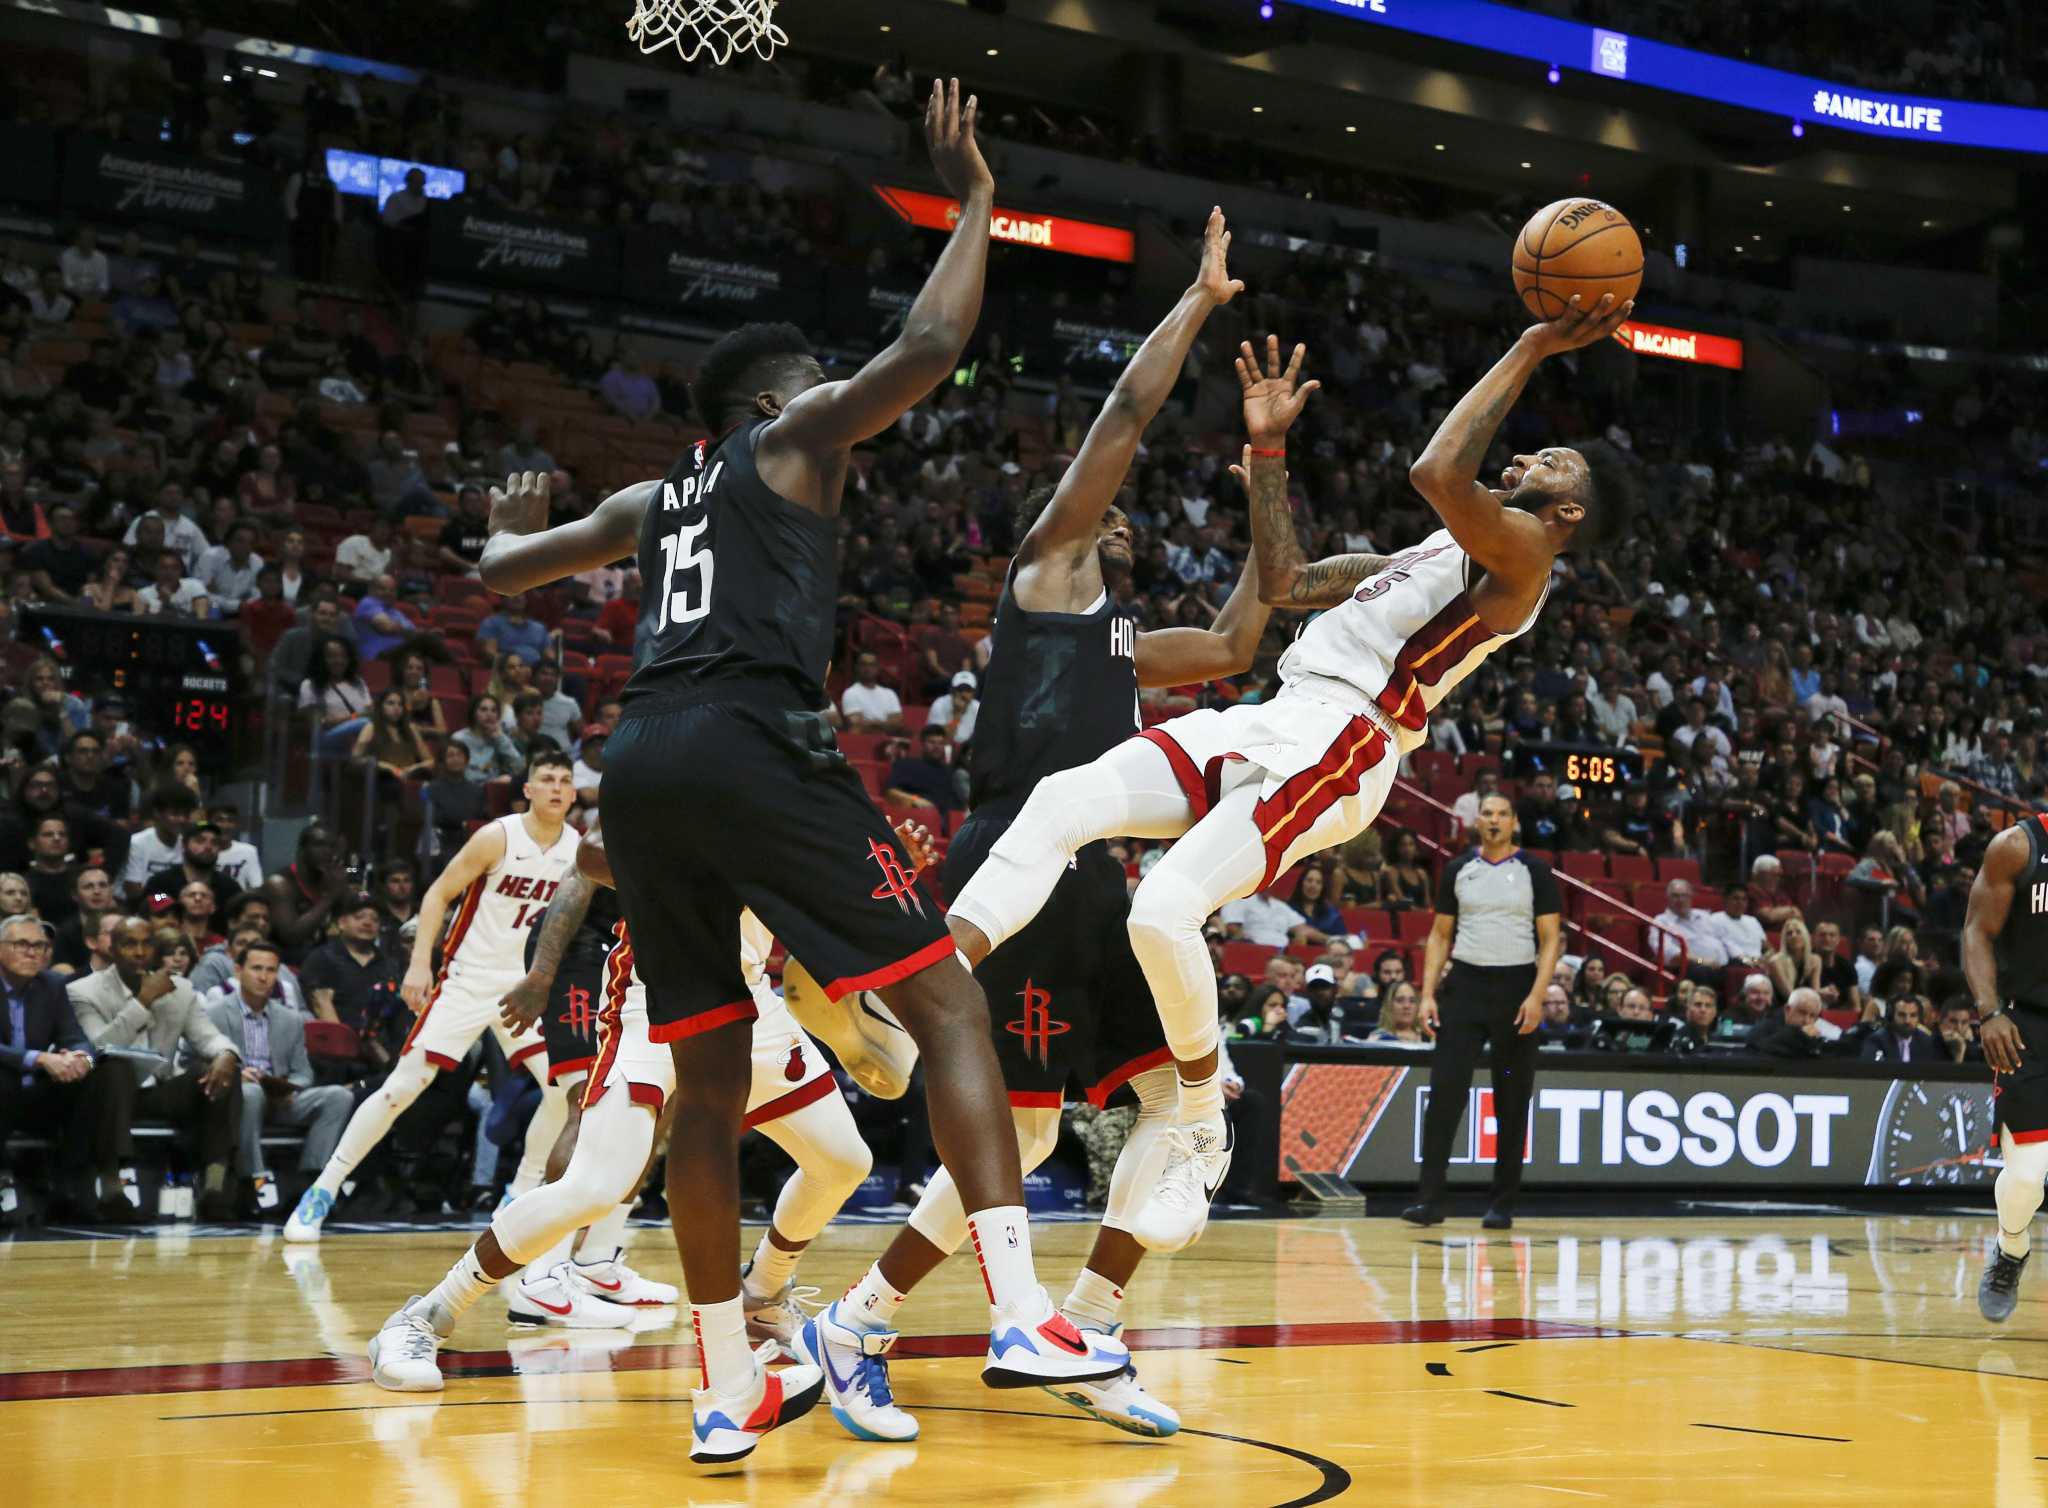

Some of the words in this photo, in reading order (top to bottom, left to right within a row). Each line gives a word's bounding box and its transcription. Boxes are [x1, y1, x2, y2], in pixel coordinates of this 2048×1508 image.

[1813, 90, 1942, 132] #AMEXLIFE
[989, 216, 1053, 246] ACARDÍ
[1633, 330, 1696, 359] BACARDÍ
[657, 514, 714, 635] 15
[175, 699, 229, 730] 124
[1567, 754, 1615, 783] 6:05
[496, 874, 560, 902] HEAT
[1539, 1088, 1849, 1168] TISSOT
